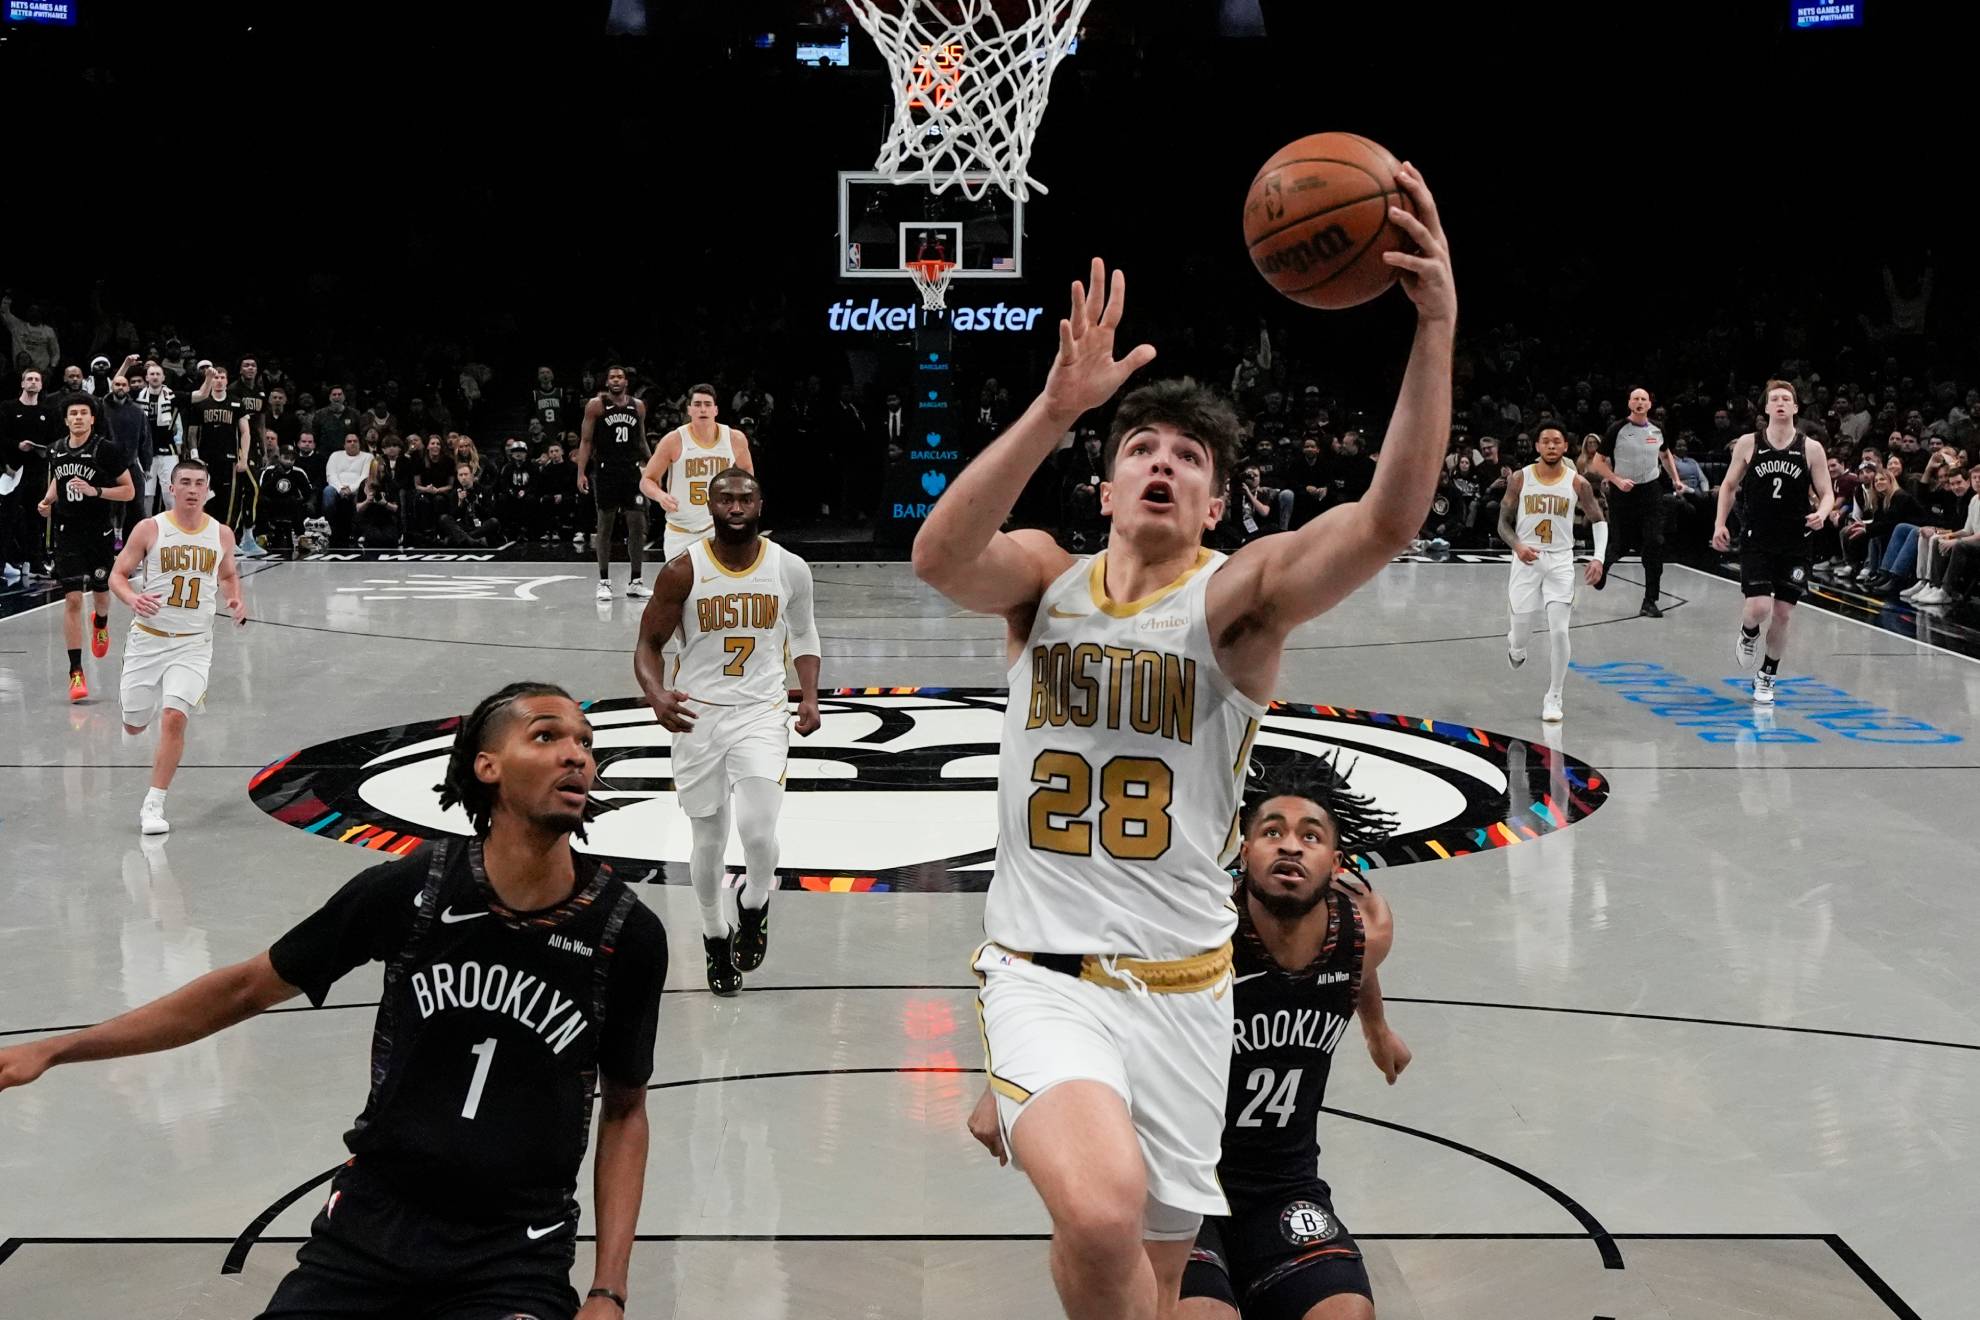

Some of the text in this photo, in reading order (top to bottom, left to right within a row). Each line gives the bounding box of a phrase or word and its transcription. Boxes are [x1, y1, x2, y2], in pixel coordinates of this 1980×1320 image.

[11, 1, 28, 9] NETS
[29, 3, 53, 11] GAMES
[1798, 4, 1854, 16] NETS GAMES ARE
[828, 299, 1043, 331] ticketaster
[203, 409, 233, 424] BOSTON
[545, 409, 555, 422] 9
[604, 413, 637, 427] BROOKLYN
[615, 426, 629, 443] 20
[910, 451, 958, 459] BARCLAYS
[1754, 460, 1803, 479] BROOKLYN
[690, 482, 709, 506] 5
[1772, 477, 1783, 499] 2
[1524, 494, 1570, 518] BOSTON
[1535, 519, 1553, 544] 4
[160, 545, 217, 576] BOSTON
[377, 553, 495, 561] WON
[167, 575, 200, 609] 11
[697, 593, 779, 632] BOSTON
[723, 637, 755, 676] 7
[1025, 642, 1196, 746] BOSTON
[1027, 749, 1174, 860] 28
[548, 933, 593, 957] All In Won
[1317, 971, 1350, 985] All In Won
[411, 961, 588, 1055] BROOKLYN
[1233, 1008, 1348, 1054] ROOKLYN
[461, 1037, 498, 1120] 1
[1236, 1068, 1303, 1128] 24
